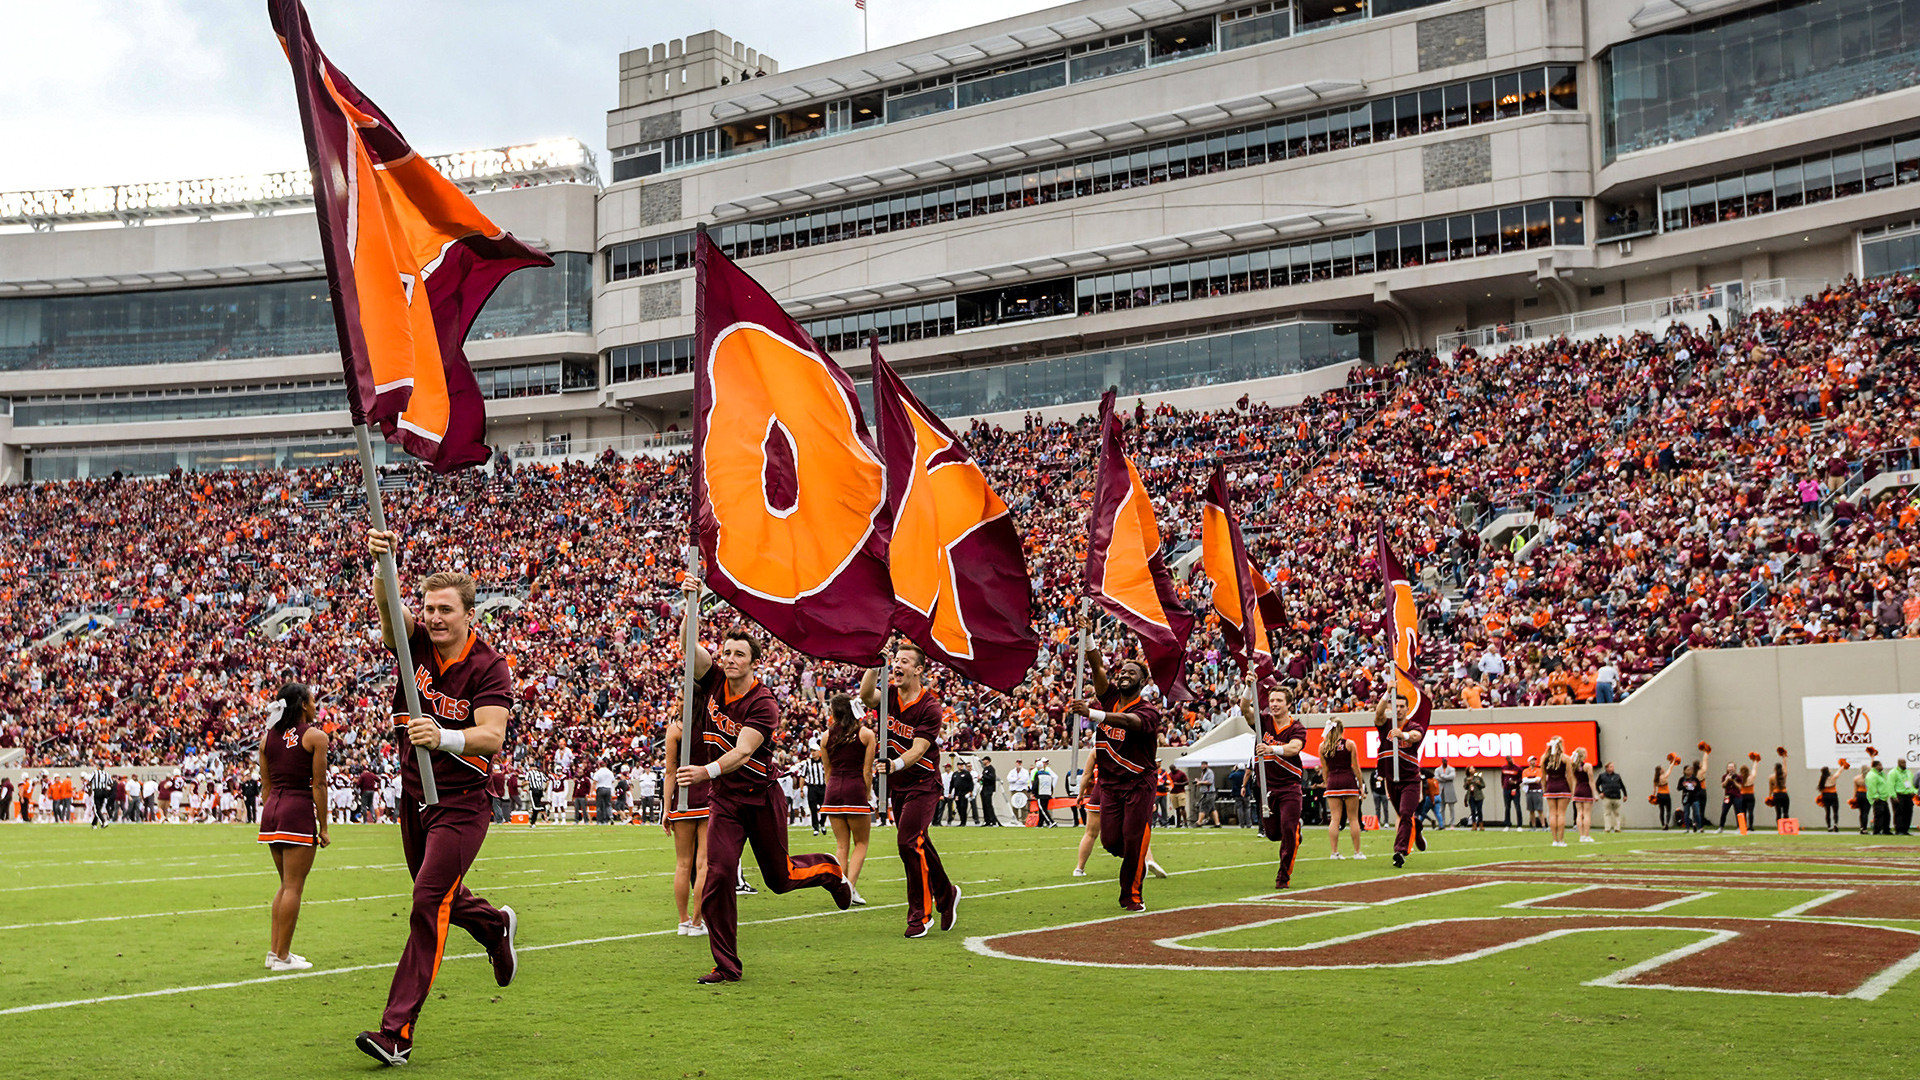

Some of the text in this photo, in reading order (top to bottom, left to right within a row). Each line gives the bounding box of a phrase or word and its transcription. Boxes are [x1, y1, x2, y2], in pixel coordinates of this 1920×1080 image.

[703, 321, 887, 604] O
[887, 714, 917, 740] OKIE
[1836, 733, 1871, 744] VCOM
[1783, 821, 1794, 833] G
